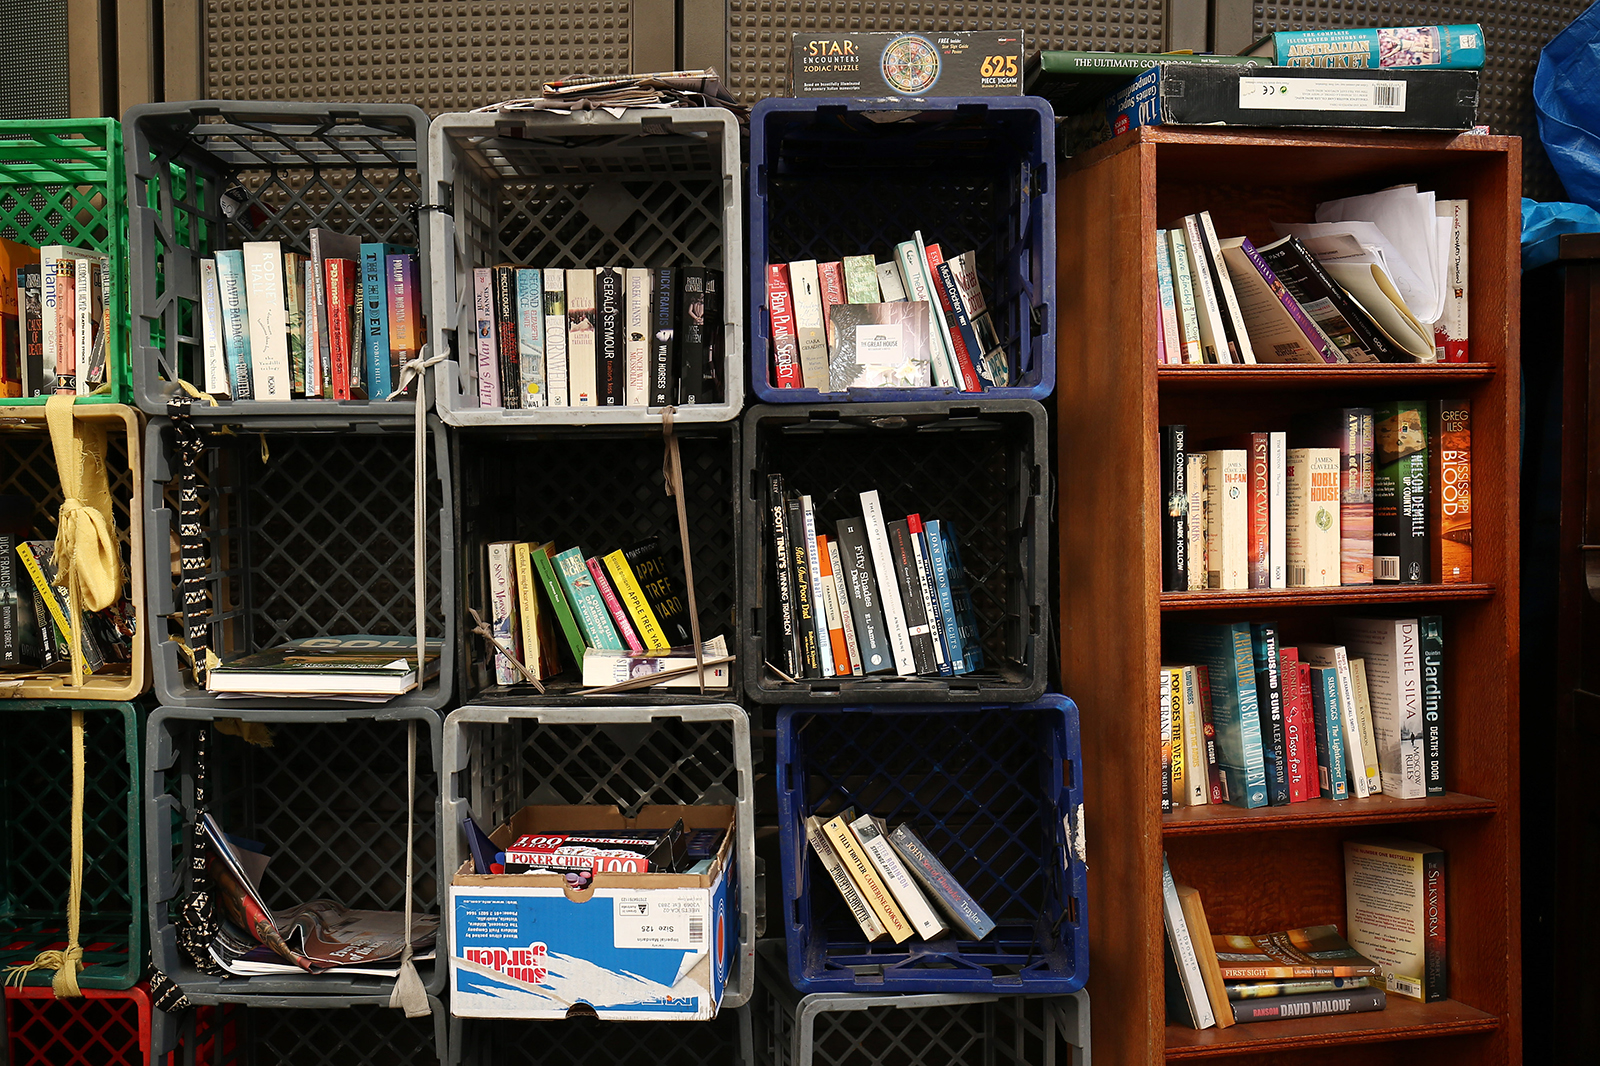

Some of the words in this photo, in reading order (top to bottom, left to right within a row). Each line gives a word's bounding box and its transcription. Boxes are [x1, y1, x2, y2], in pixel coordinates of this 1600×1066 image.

[809, 40, 855, 56] STAR
[1287, 53, 1370, 68] CRICKET
[1288, 41, 1370, 57] AUSTRALIAN
[980, 55, 1018, 77] 625
[1118, 96, 1135, 112] Super
[1136, 85, 1156, 102] Games
[1139, 97, 1157, 126] 110
[1175, 243, 1186, 271] Maeve
[78, 263, 87, 293] GEORGETTE
[251, 264, 262, 295] HALL
[263, 252, 277, 306] RODNEY
[520, 272, 530, 308] CHANCE
[529, 272, 539, 308] SECOND
[631, 276, 640, 299] DEREK
[660, 270, 670, 289] DICK
[1179, 274, 1192, 306] Binchy
[79, 294, 87, 311] HEYER
[604, 277, 613, 313] GERALD
[659, 292, 670, 325] FRANCIS
[632, 300, 641, 327] HANSEN
[604, 315, 614, 359] SEYMOUR
[480, 341, 490, 367] War
[547, 326, 566, 393] CORNWELL
[658, 345, 667, 361] WILD
[480, 372, 494, 407] Lily's
[657, 363, 666, 389] HORSES
[1442, 410, 1468, 420] GREG
[1446, 422, 1463, 432] ILES
[1176, 431, 1184, 450] JOHN
[1348, 421, 1357, 456] Woman
[1362, 415, 1371, 444] NOEL
[1349, 458, 1358, 467] of
[1363, 446, 1372, 494] BARBER
[1410, 455, 1423, 493] NELSON
[1312, 472, 1338, 486] NOBLE
[1349, 468, 1358, 494] Cairo
[1403, 477, 1411, 486] UP
[1442, 450, 1457, 516] BLOOD
[1458, 450, 1468, 514] MISSISSIPPI
[1191, 492, 1200, 512] SHELL
[1311, 487, 1339, 502] HOUSE
[1403, 487, 1411, 517] COUNTRY
[1192, 514, 1201, 542] SEEKERS
[1411, 496, 1424, 538] DEMILLE
[0, 536, 10, 555] DICK
[795, 546, 806, 564] Rich
[0, 556, 11, 588] FRANCIS
[21, 550, 36, 574] NUMBER
[32, 577, 47, 595] FREAK
[797, 566, 807, 584] Dad
[851, 569, 863, 599] Darker
[799, 584, 809, 602] Poor
[926, 576, 936, 598] Lorayne
[930, 532, 939, 553] JOAN
[935, 557, 946, 588] DIDION
[941, 592, 951, 614] BLUE
[946, 617, 958, 650] NIGHTS
[802, 604, 811, 619] Dad
[825, 585, 835, 621] FRANKENSTEIN
[920, 576, 932, 614] MEMORY
[930, 619, 939, 643] BOOK
[592, 600, 606, 623] QUIVER
[602, 624, 614, 642] FULL
[1233, 632, 1255, 687] CRUSADE
[1267, 638, 1276, 688] THOUSAND
[1402, 624, 1414, 675] DANIEL
[1328, 676, 1336, 698] SUSAN
[1405, 680, 1416, 719] SILVA
[1424, 657, 1440, 722] Jardine
[1240, 690, 1261, 738] ANSELM
[1270, 692, 1279, 721] SUNS
[1329, 699, 1338, 720] WIGGS
[1273, 723, 1281, 743] ALEX
[1430, 726, 1439, 757] DEATH'S
[1173, 744, 1181, 782] WEASEL
[1207, 741, 1216, 764] DECIDER
[1245, 743, 1265, 787] AUDLEY
[1274, 745, 1284, 784] SCARROW
[1332, 739, 1343, 778] Lightkeeper
[1405, 754, 1414, 780] RULES
[1431, 761, 1439, 780] DOOR
[512, 853, 554, 864] POKER
[556, 856, 593, 867] CHIPS
[595, 859, 637, 873] 100
[830, 863, 850, 890] GEORGE
[838, 834, 852, 849] TILLY
[846, 848, 867, 874] TROTTER
[863, 875, 889, 906] CATHERINE
[883, 905, 904, 931] COOKSON
[846, 890, 871, 923] ELIZABETH
[1428, 870, 1440, 937] SILKWORM
[467, 945, 546, 971] garden
[507, 967, 546, 984] sun
[1253, 1008, 1279, 1017] RANSOM
[1280, 1002, 1310, 1017] DAVID
[1312, 999, 1351, 1013] MALOUF
